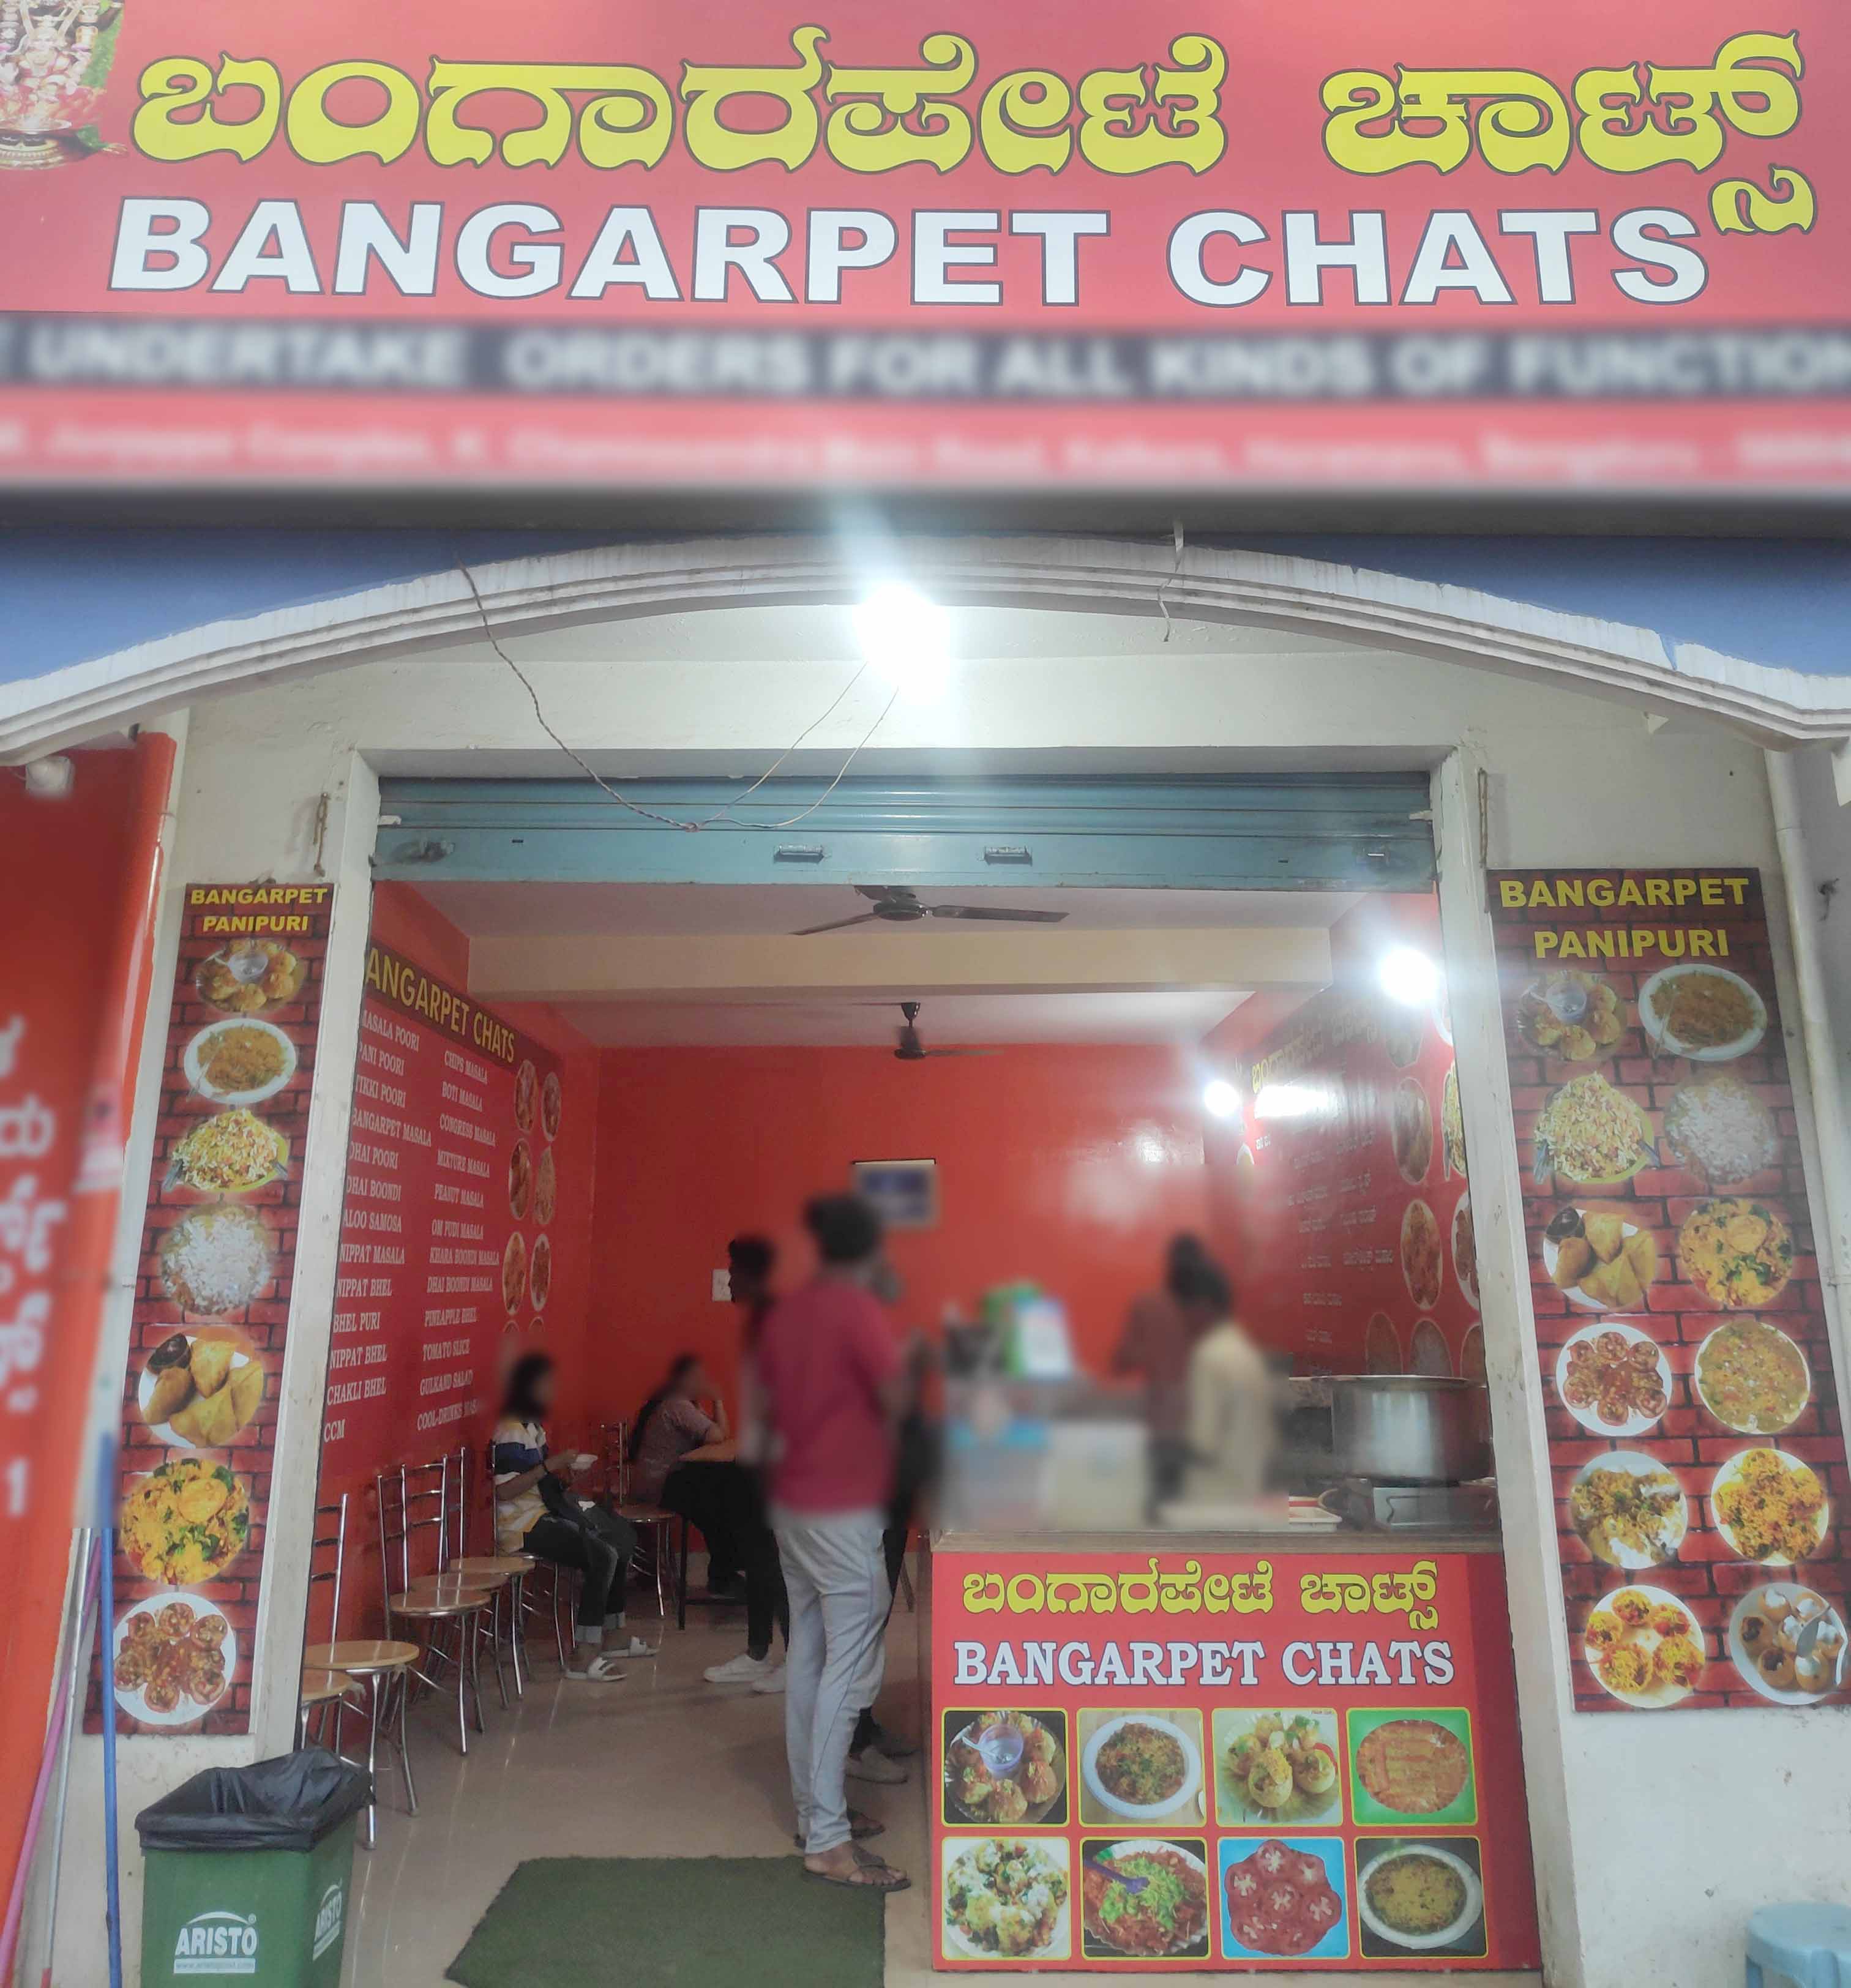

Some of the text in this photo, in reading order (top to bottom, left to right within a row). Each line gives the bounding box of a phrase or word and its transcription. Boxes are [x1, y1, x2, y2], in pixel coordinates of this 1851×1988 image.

[129, 24, 1816, 235] ಬಂಗಾರಪೇಟೆ ಚಾಟ್ಸ್
[107, 195, 1710, 307] BANGARPET CHATS
[190, 888, 327, 905] BANGARPET
[1498, 877, 1749, 908] BANGARPET
[203, 915, 308, 932] PANIPURI
[1534, 929, 1729, 958] PANIPURI
[365, 947, 515, 1063] ANGARPET CHATS
[395, 1026, 421, 1053] POORI
[379, 1050, 405, 1077] POORI
[444, 1050, 488, 1085] CHIPS MASALA
[380, 1083, 406, 1108] POORI
[441, 1082, 483, 1112] BOTI MASALA
[353, 1107, 432, 1147] BANGARPET MASALA
[439, 1113, 496, 1147] CONGRESS MASALA
[372, 1146, 399, 1170] POORI
[436, 1148, 490, 1178] MIXTURE MASALA
[346, 1175, 402, 1202] DHAI BOONDI
[434, 1184, 484, 1209] PEANUT MASALA
[343, 1209, 402, 1233] ALOO SAMOSA
[431, 1219, 443, 1236] OM
[460, 1223, 484, 1240] MASALA
[339, 1244, 405, 1265] NIPPAT MASALA
[429, 1247, 453, 1264] KHARA
[478, 1250, 500, 1266] MASALA
[336, 1278, 392, 1298] NIPPAT BHEL
[426, 1276, 445, 1293] DHAI
[471, 1276, 493, 1293] MASALA
[332, 1312, 381, 1333] BHEL PURI
[424, 1308, 461, 1328] PINEAPPLE
[329, 1344, 387, 1371] NIPPAT BHEL
[422, 1341, 452, 1362] TOMATO
[326, 1377, 387, 1406] CHAKLI BHEL
[323, 1418, 346, 1443] CCM
[962, 1556, 1440, 1631] ಬಂಗಾರಪೇಟೆ ಚಾಟ್ಸ್
[953, 1640, 1456, 1687] BANGARPET CHATS
[174, 1926, 258, 1956] ARISTO
